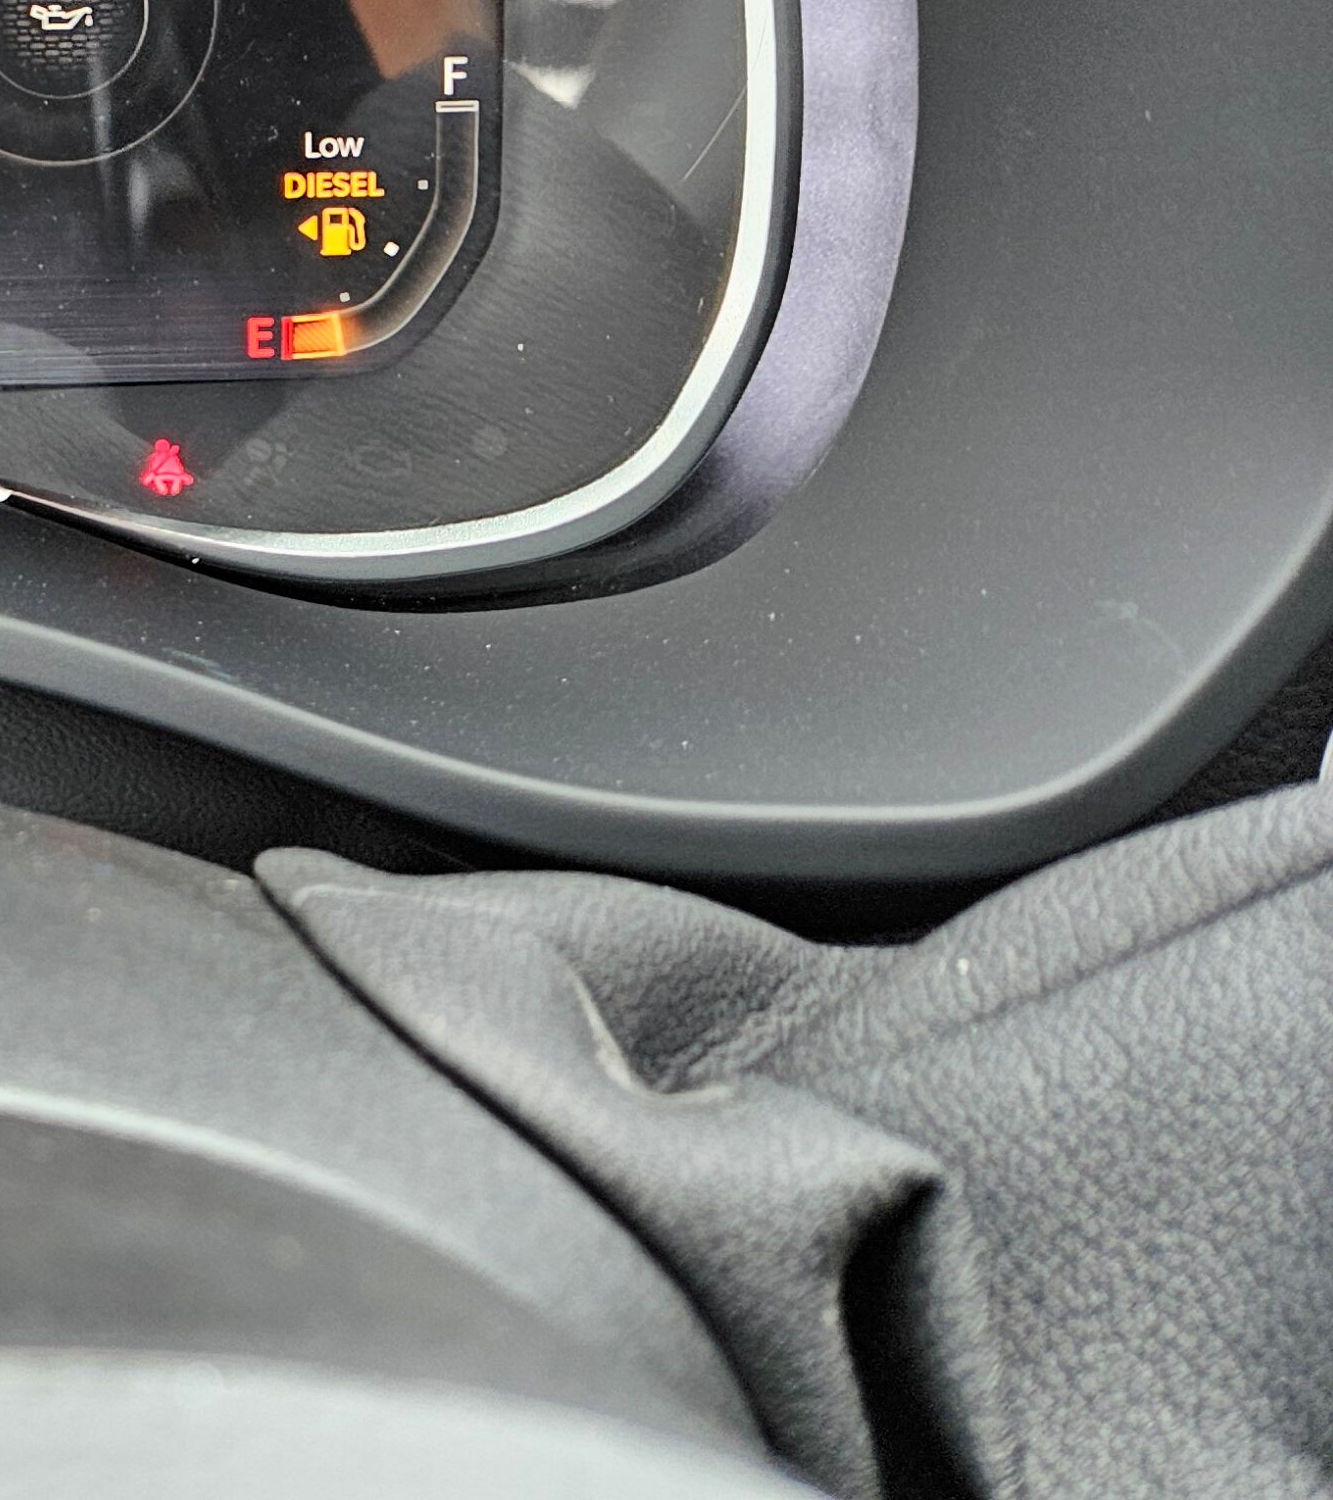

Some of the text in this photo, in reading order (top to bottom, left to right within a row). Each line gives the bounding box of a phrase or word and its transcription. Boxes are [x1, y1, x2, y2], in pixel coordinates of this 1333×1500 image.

[443, 56, 469, 94] F
[305, 132, 365, 158] Low
[283, 172, 385, 200] DIESEL
[247, 315, 275, 359] E
